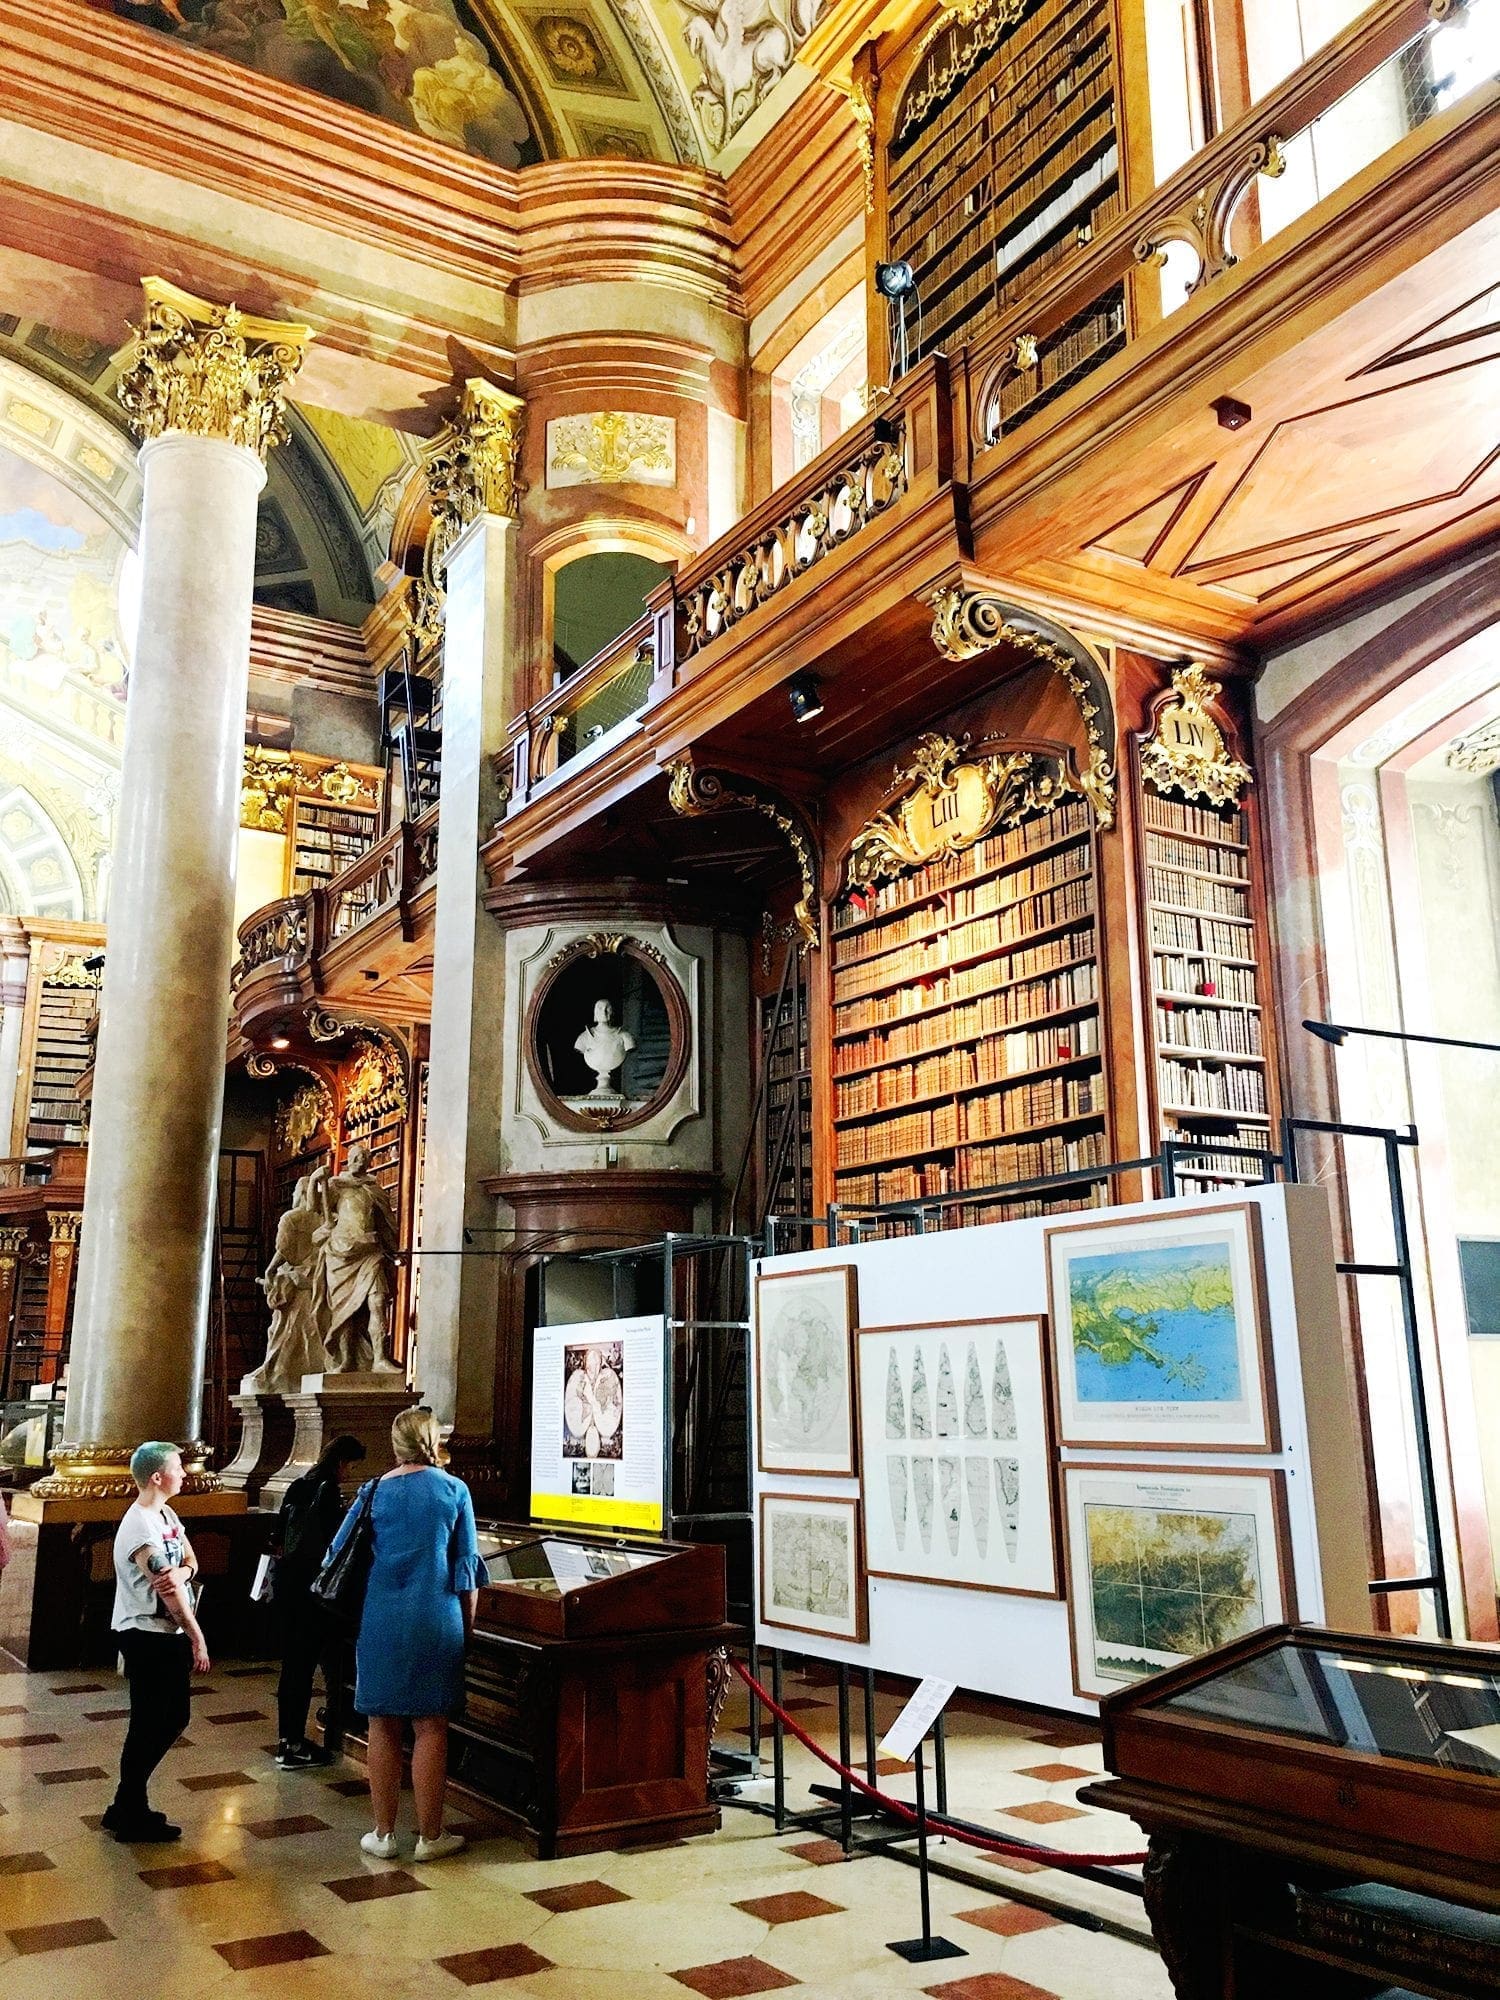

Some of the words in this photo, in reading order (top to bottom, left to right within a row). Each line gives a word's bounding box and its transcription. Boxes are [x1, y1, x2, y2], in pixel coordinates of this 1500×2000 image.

[930, 793, 960, 828] LIII
[1287, 1445, 1293, 1453] 4
[1290, 1469, 1296, 1477] 5
